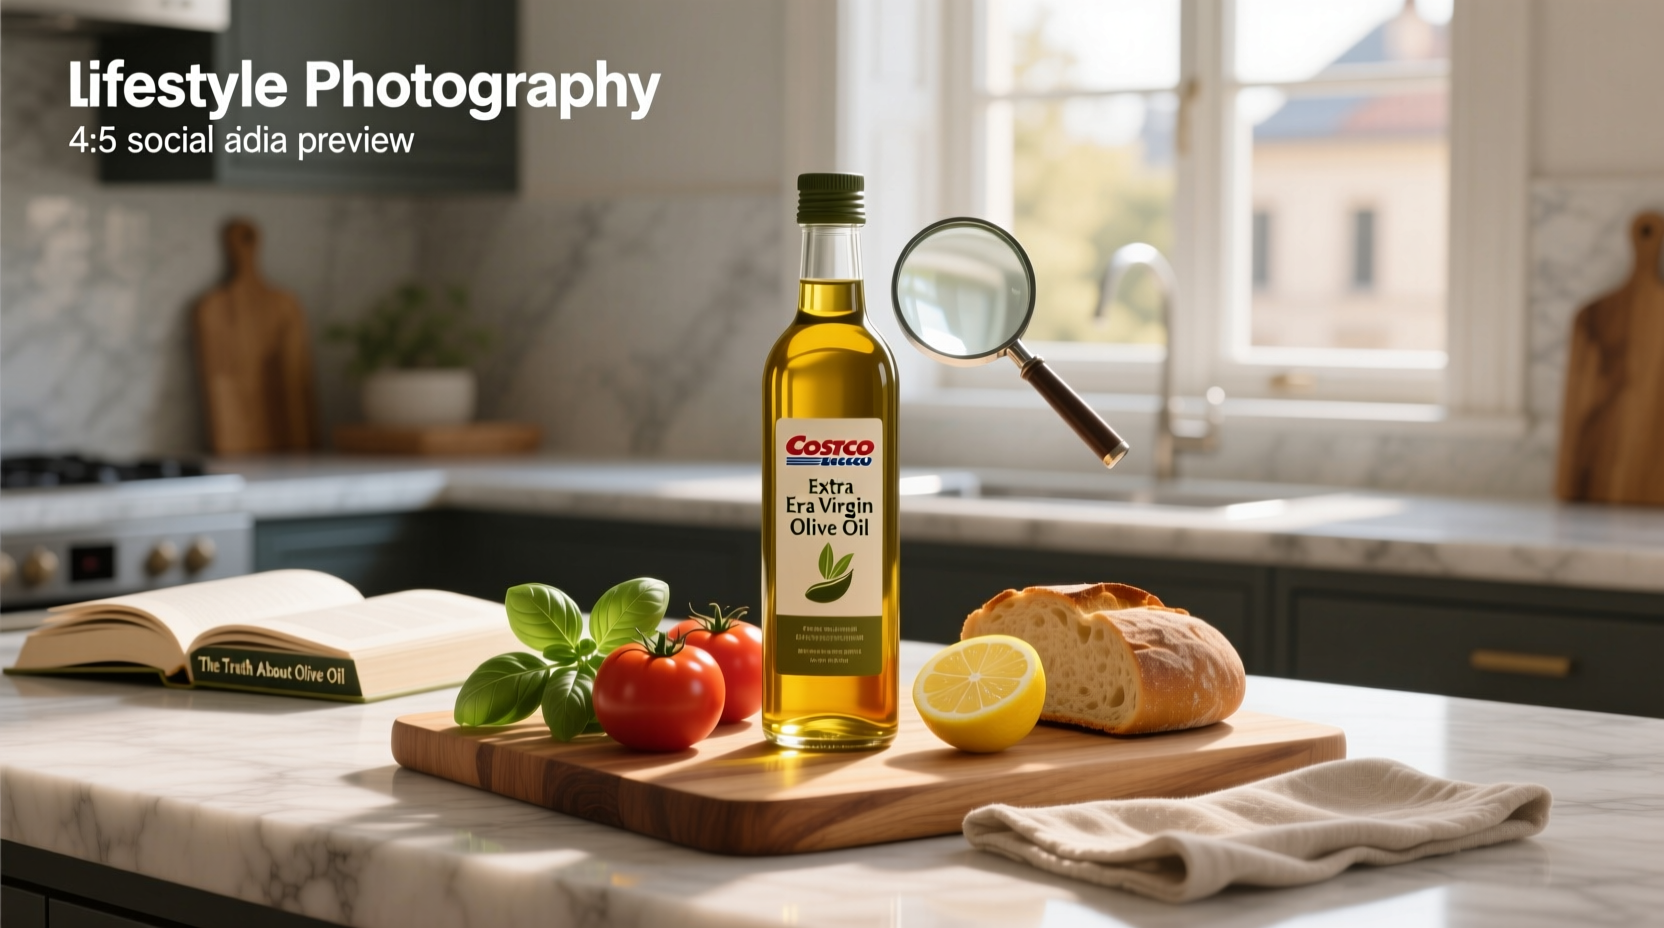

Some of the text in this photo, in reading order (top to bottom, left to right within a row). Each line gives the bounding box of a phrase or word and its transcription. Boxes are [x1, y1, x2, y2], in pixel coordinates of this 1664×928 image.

[808, 478, 854, 495] Extra
[786, 496, 873, 519] Era Virgin
[790, 517, 869, 536] Olive Oil
[198, 656, 345, 685] The Truth About Olive Oil
